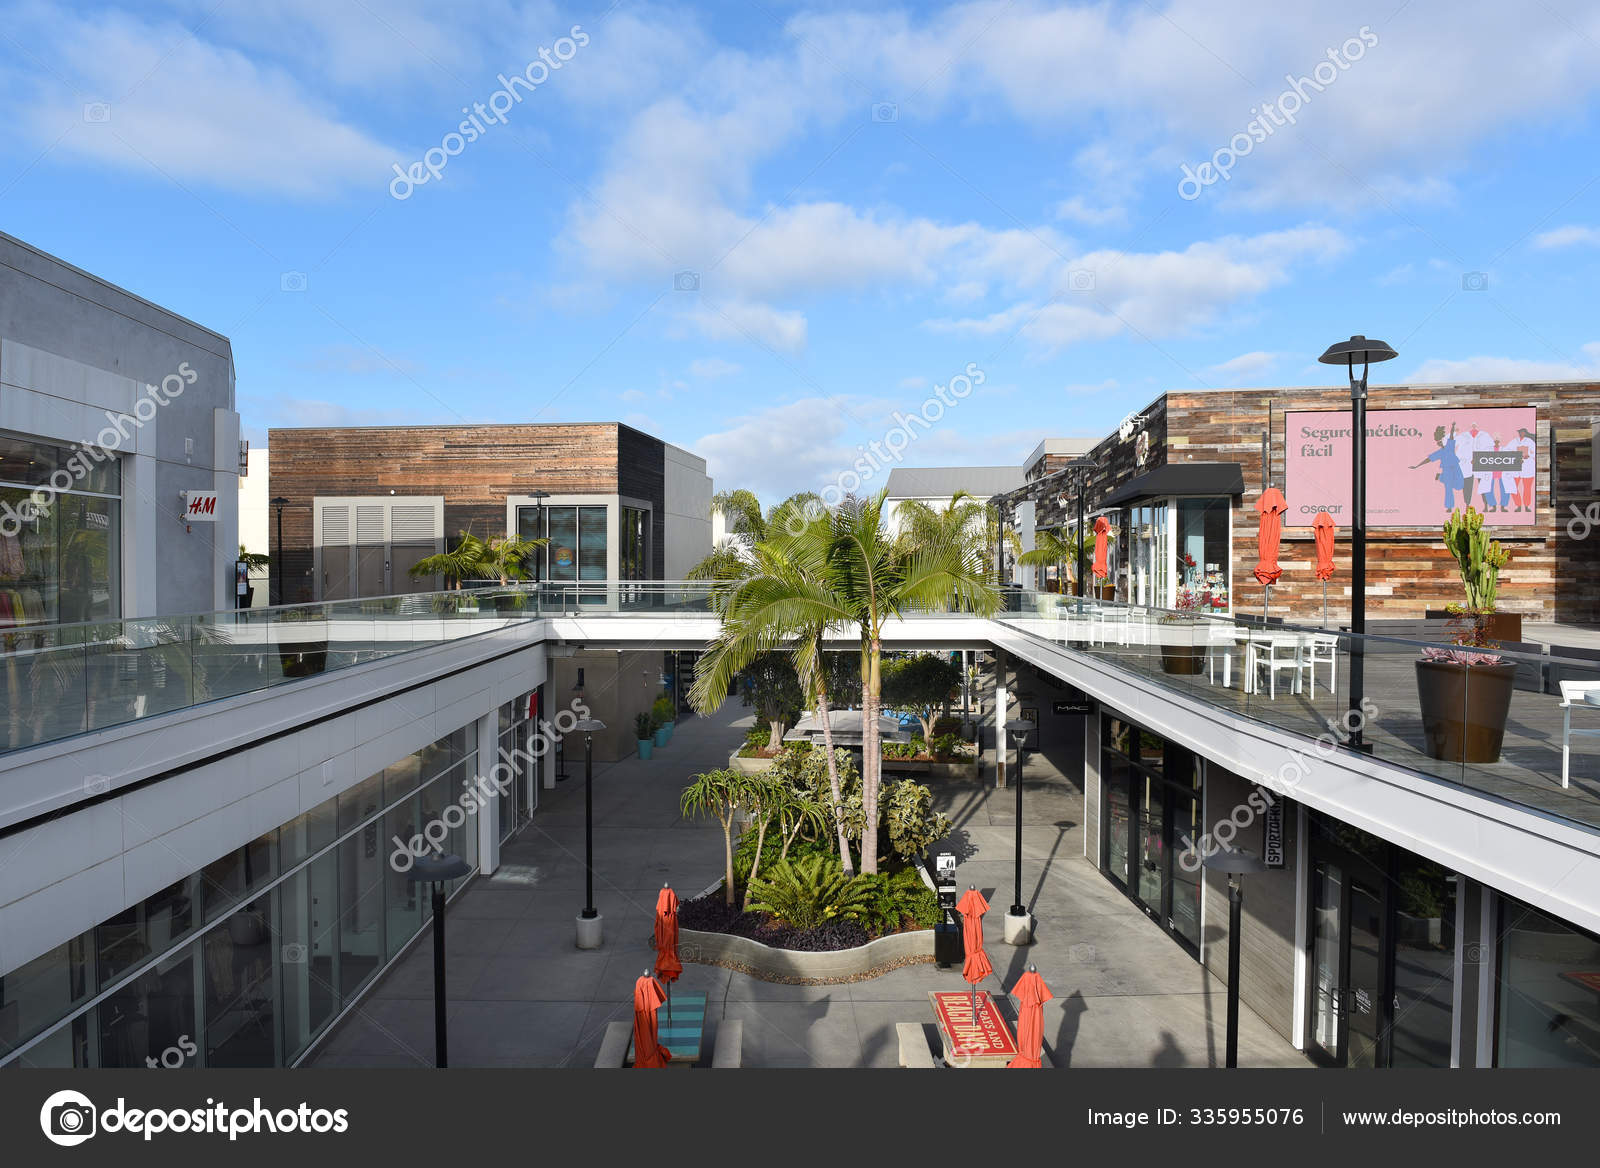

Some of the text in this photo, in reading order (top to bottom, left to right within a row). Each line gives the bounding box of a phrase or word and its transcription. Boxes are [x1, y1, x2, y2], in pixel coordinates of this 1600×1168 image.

[1300, 444, 1333, 457] fácil
[1479, 457, 1516, 465] oscar
[189, 496, 217, 515] H&M
[1299, 504, 1343, 514] oscar
[979, 1010, 996, 1030] RAYS
[952, 1025, 991, 1050] DAYS
[986, 1030, 1005, 1049] AND
